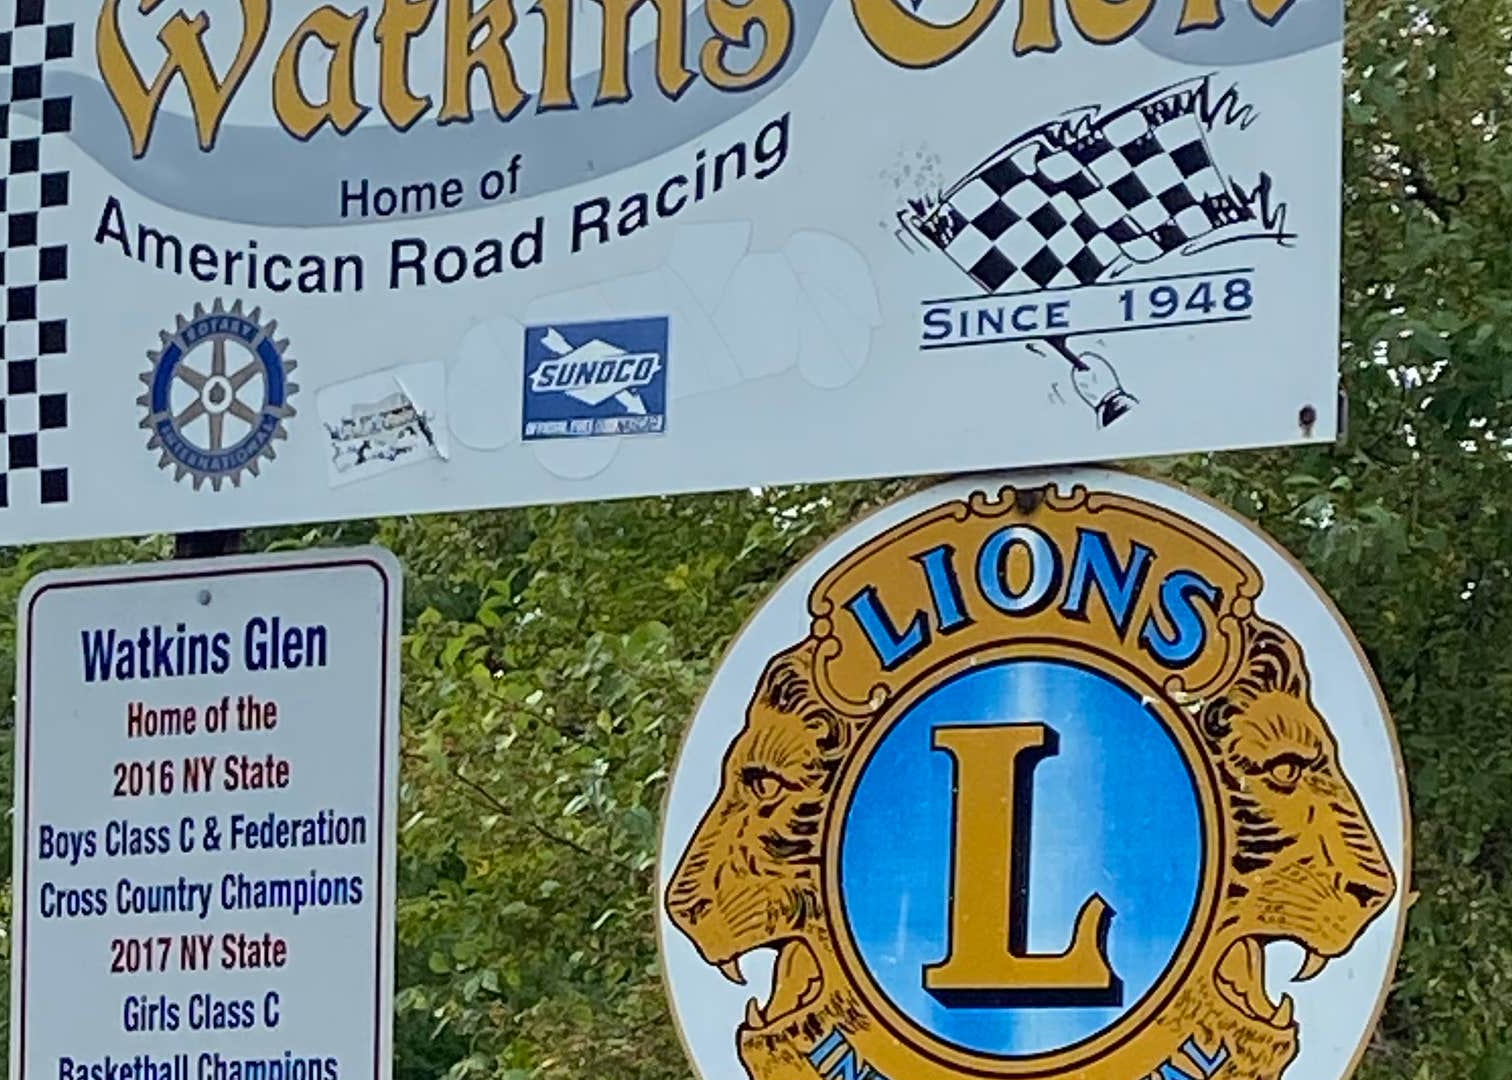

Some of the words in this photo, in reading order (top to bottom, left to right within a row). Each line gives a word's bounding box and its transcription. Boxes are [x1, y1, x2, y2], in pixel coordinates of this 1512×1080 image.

[96, 0, 793, 159] Watkins
[95, 196, 363, 293] American
[389, 217, 545, 289] Road
[571, 112, 790, 253] Racing
[341, 176, 464, 217] Home
[480, 155, 522, 199] of
[1118, 278, 1253, 322] 1948
[538, 358, 655, 387] SUNOCO
[845, 525, 1224, 668] LIONS
[82, 623, 230, 681] Watkins
[245, 616, 328, 671] Glen
[127, 703, 196, 737] Home
[205, 697, 230, 732] of
[237, 695, 277, 730] the
[113, 759, 174, 796] 2016
[183, 757, 216, 792] NY
[224, 754, 290, 790] State
[39, 825, 96, 866] Boys
[105, 820, 170, 857] Class
[179, 817, 194, 852] C
[203, 816, 221, 851] &
[231, 810, 367, 849] Federation
[922, 722, 1124, 1008] L
[40, 882, 107, 917] Cross
[117, 877, 213, 918] Country
[221, 870, 363, 914] Champions
[111, 937, 171, 972] 2017
[180, 935, 214, 970] NY
[221, 933, 287, 969] State
[124, 995, 179, 1031] Girls
[189, 994, 255, 1029] Class
[264, 991, 280, 1027] C
